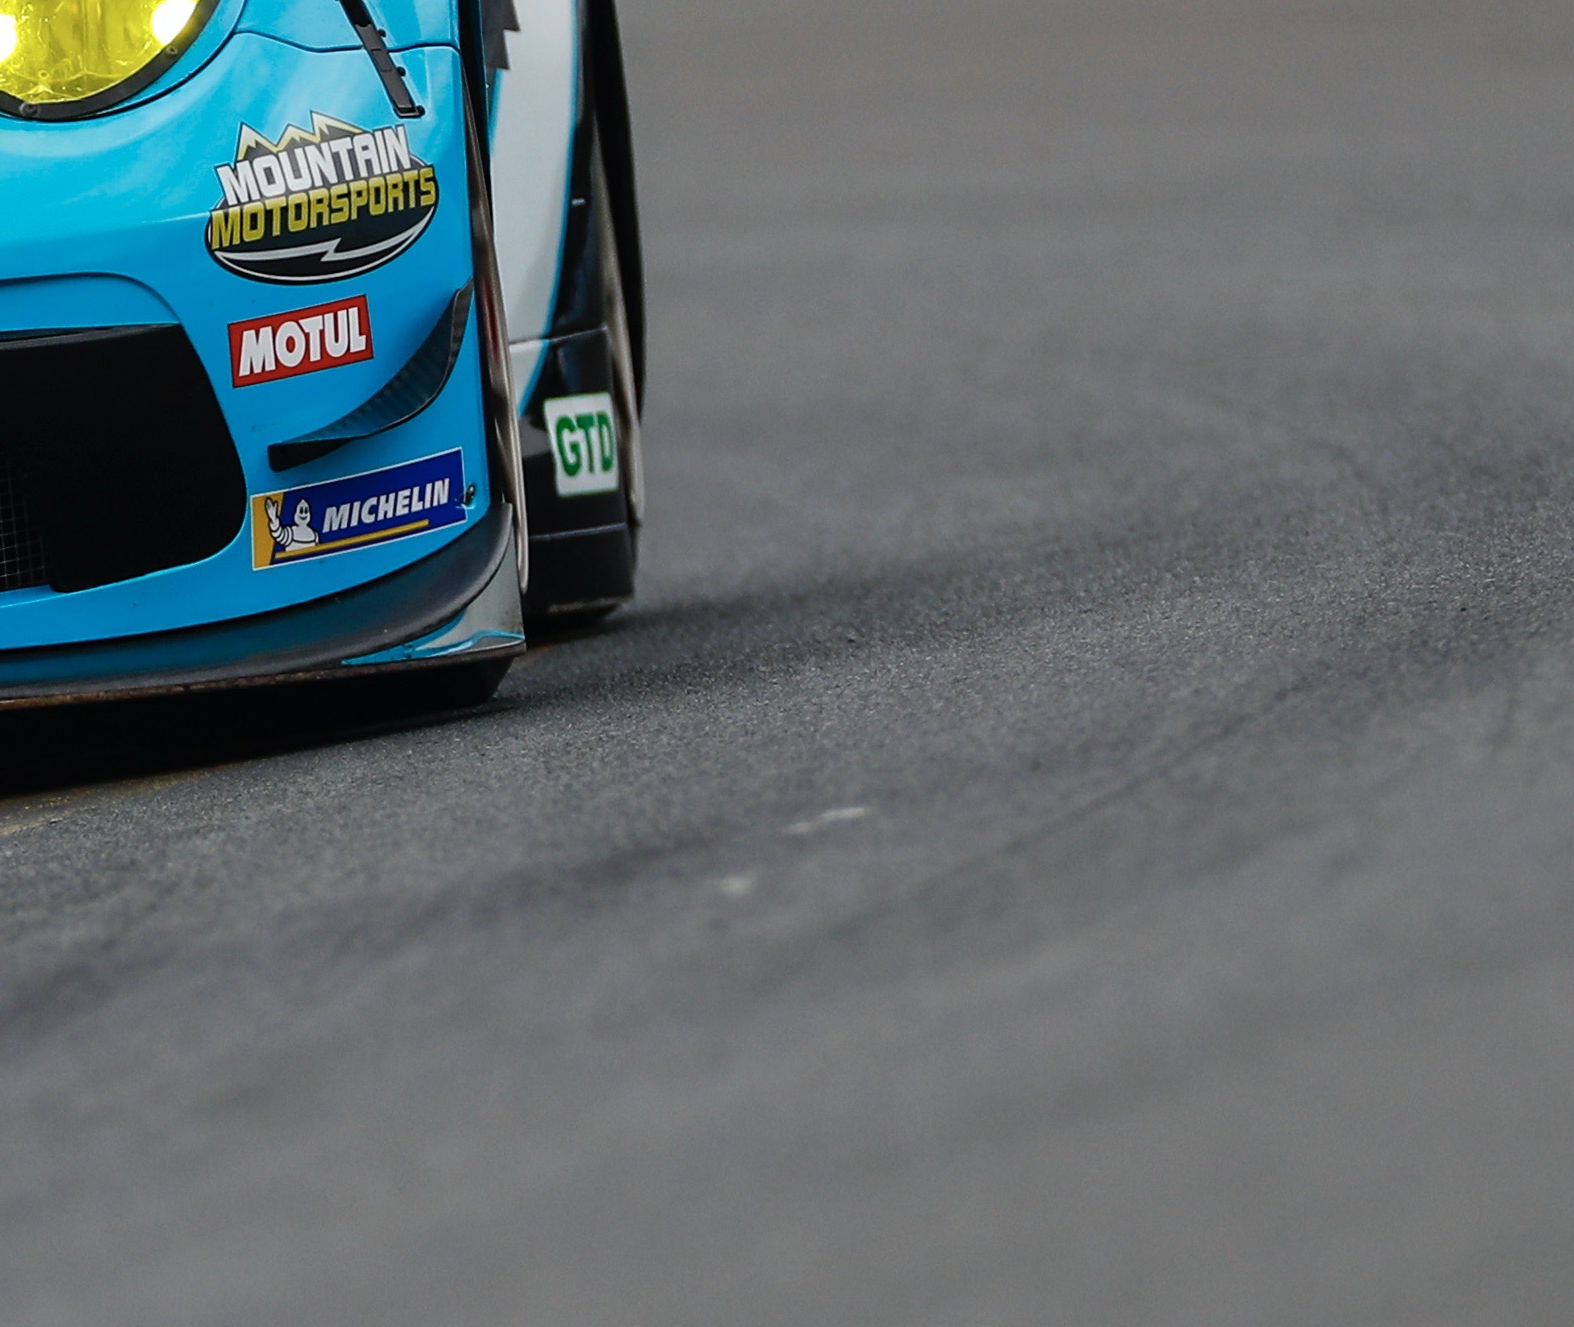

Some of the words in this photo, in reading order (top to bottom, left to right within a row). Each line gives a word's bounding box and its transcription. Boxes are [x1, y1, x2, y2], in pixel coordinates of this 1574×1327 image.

[216, 124, 413, 206] MOUNTAIN
[210, 167, 439, 251] MOTORSPORTS
[237, 306, 367, 378] MOTUL
[556, 410, 615, 478] GTD
[321, 477, 451, 533] MICHELIN
